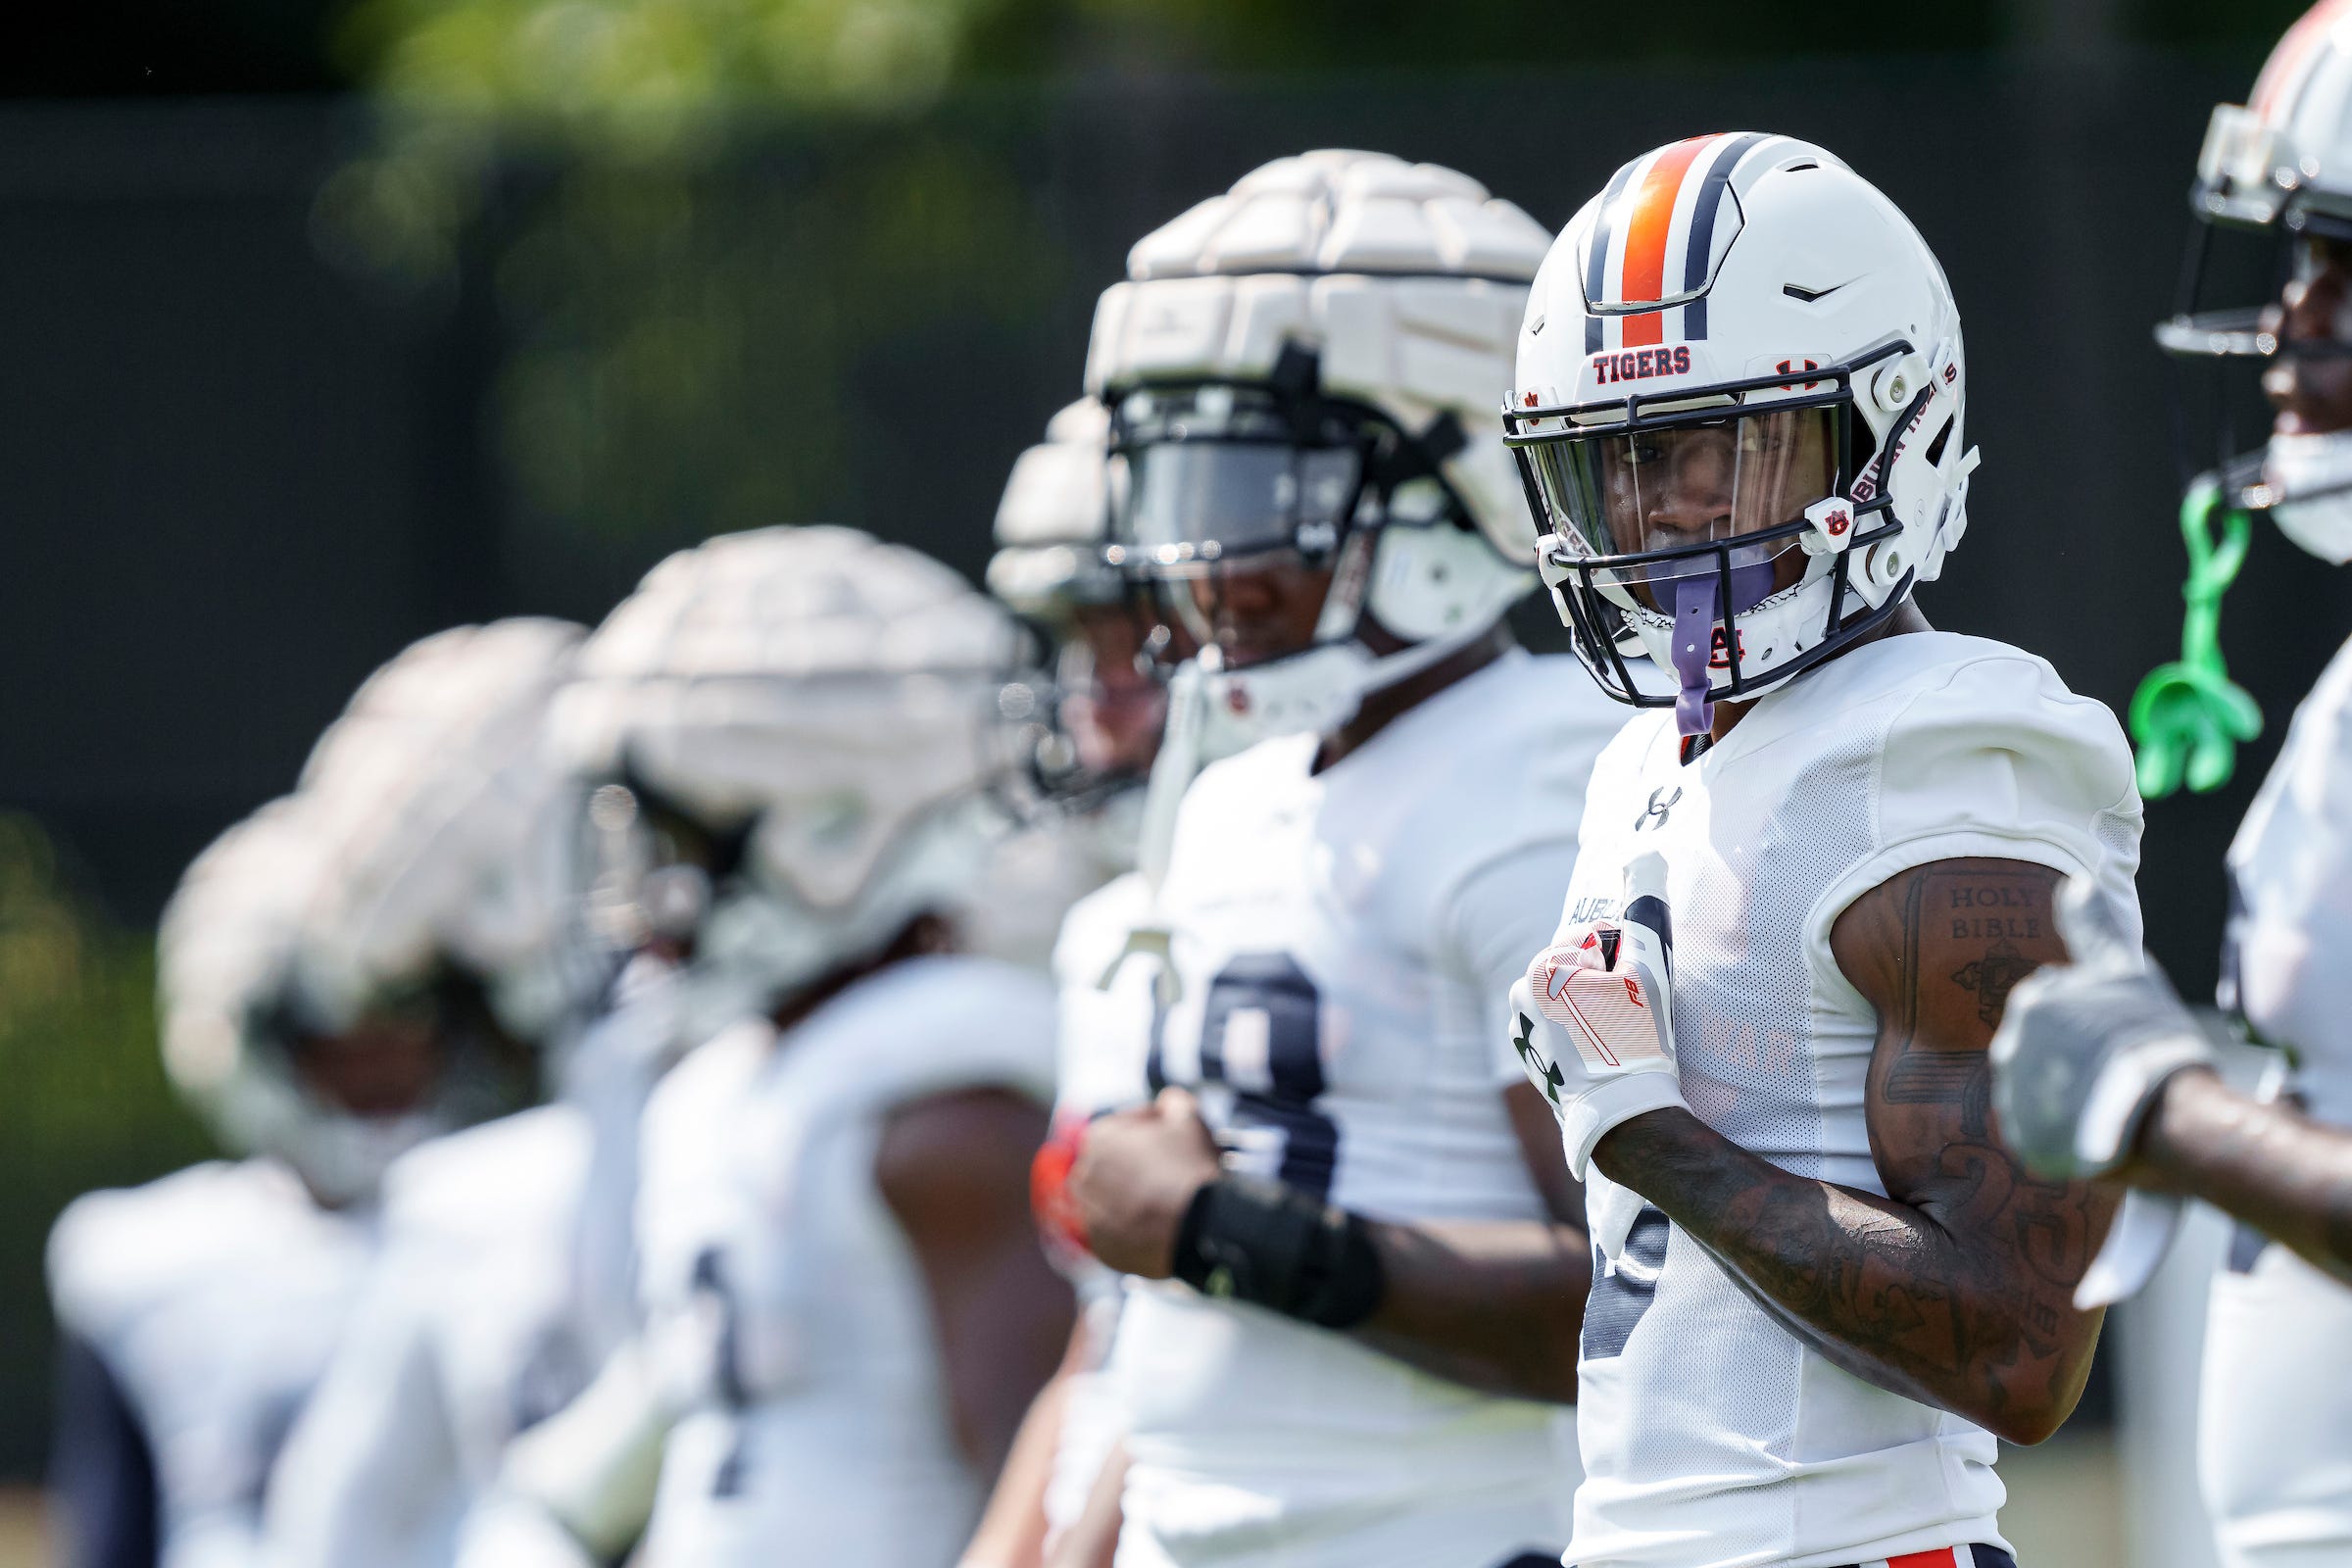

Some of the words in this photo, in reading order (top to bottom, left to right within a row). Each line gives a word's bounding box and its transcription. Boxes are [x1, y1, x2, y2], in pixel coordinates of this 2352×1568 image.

[1593, 346, 1690, 384] TIGERS
[1950, 886, 2034, 908] HOLY
[1952, 917, 2040, 940] BIBLE
[1623, 977, 1644, 1008] FB
